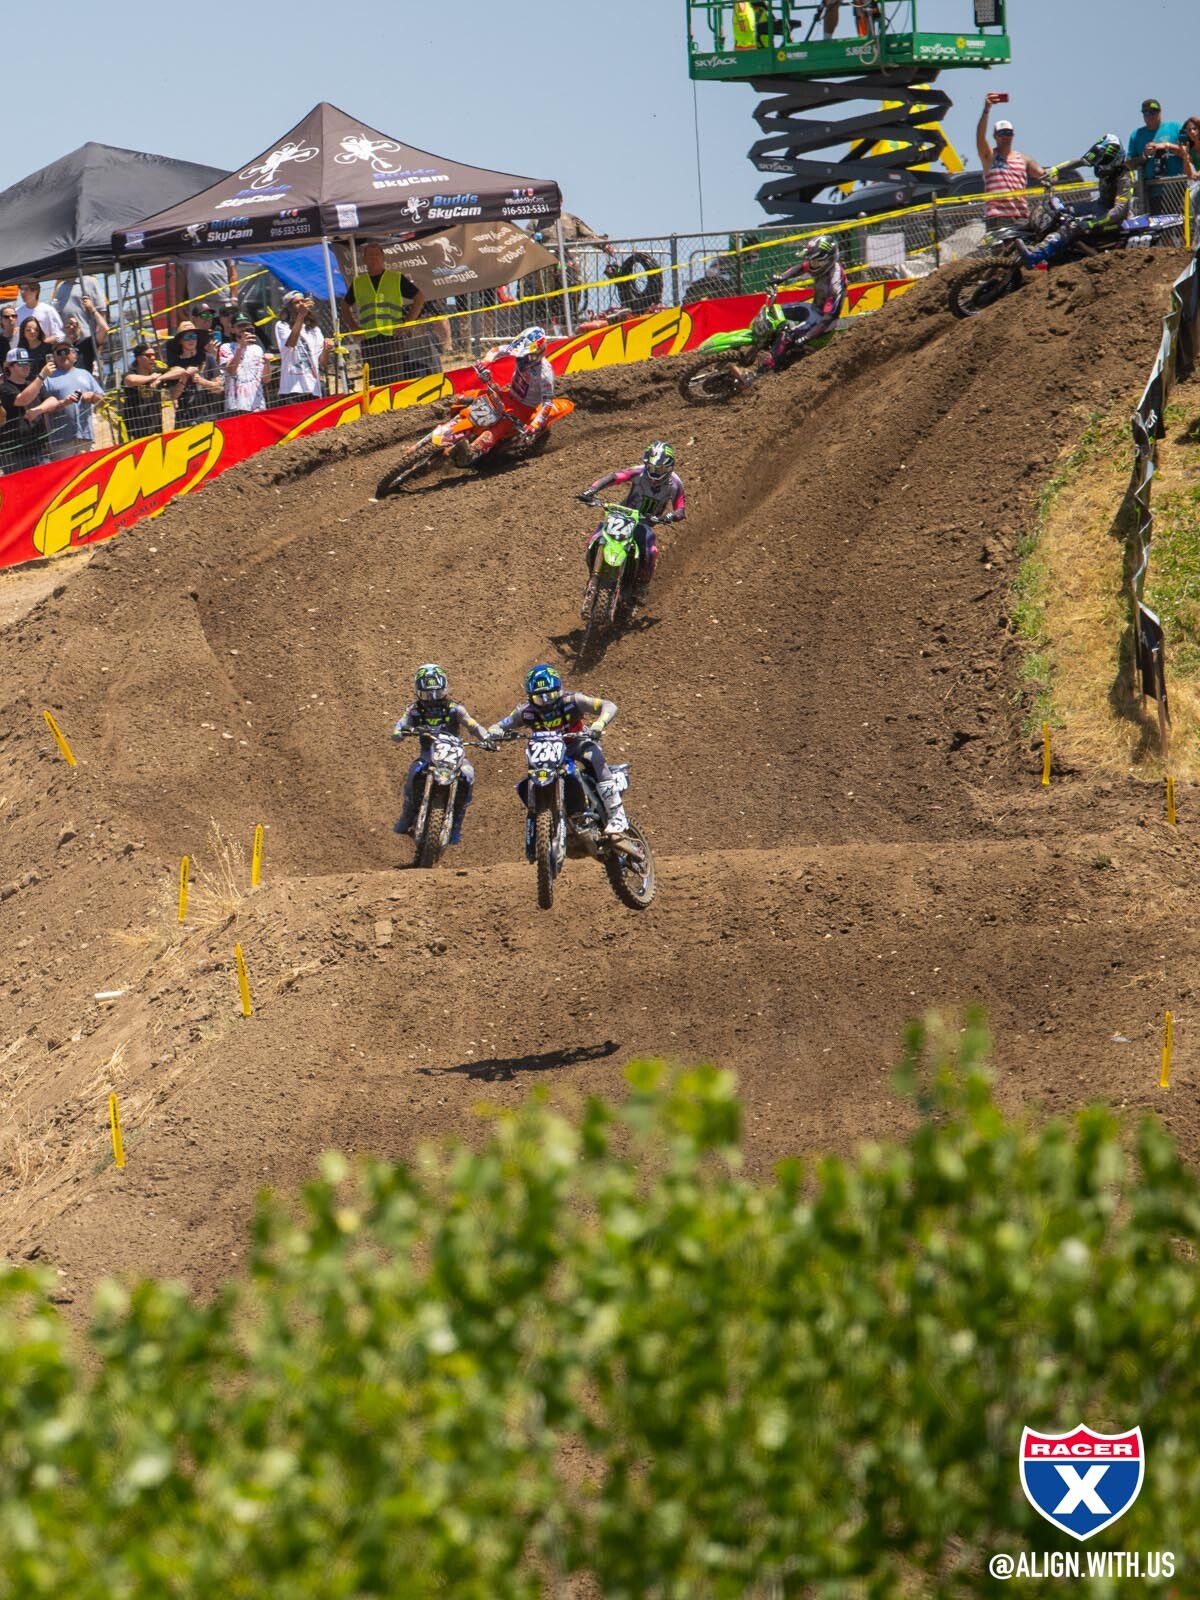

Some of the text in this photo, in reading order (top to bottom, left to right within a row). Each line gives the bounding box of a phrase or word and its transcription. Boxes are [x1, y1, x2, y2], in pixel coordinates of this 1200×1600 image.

[694, 56, 737, 67] SKYJACK
[432, 193, 479, 207] Budds
[427, 206, 482, 220] SkyCam
[501, 204, 550, 216] 916-532-5331
[207, 228, 254, 242] SkyCam
[43, 421, 216, 556] FMF
[433, 742, 464, 764] 32
[530, 741, 563, 763] 238
